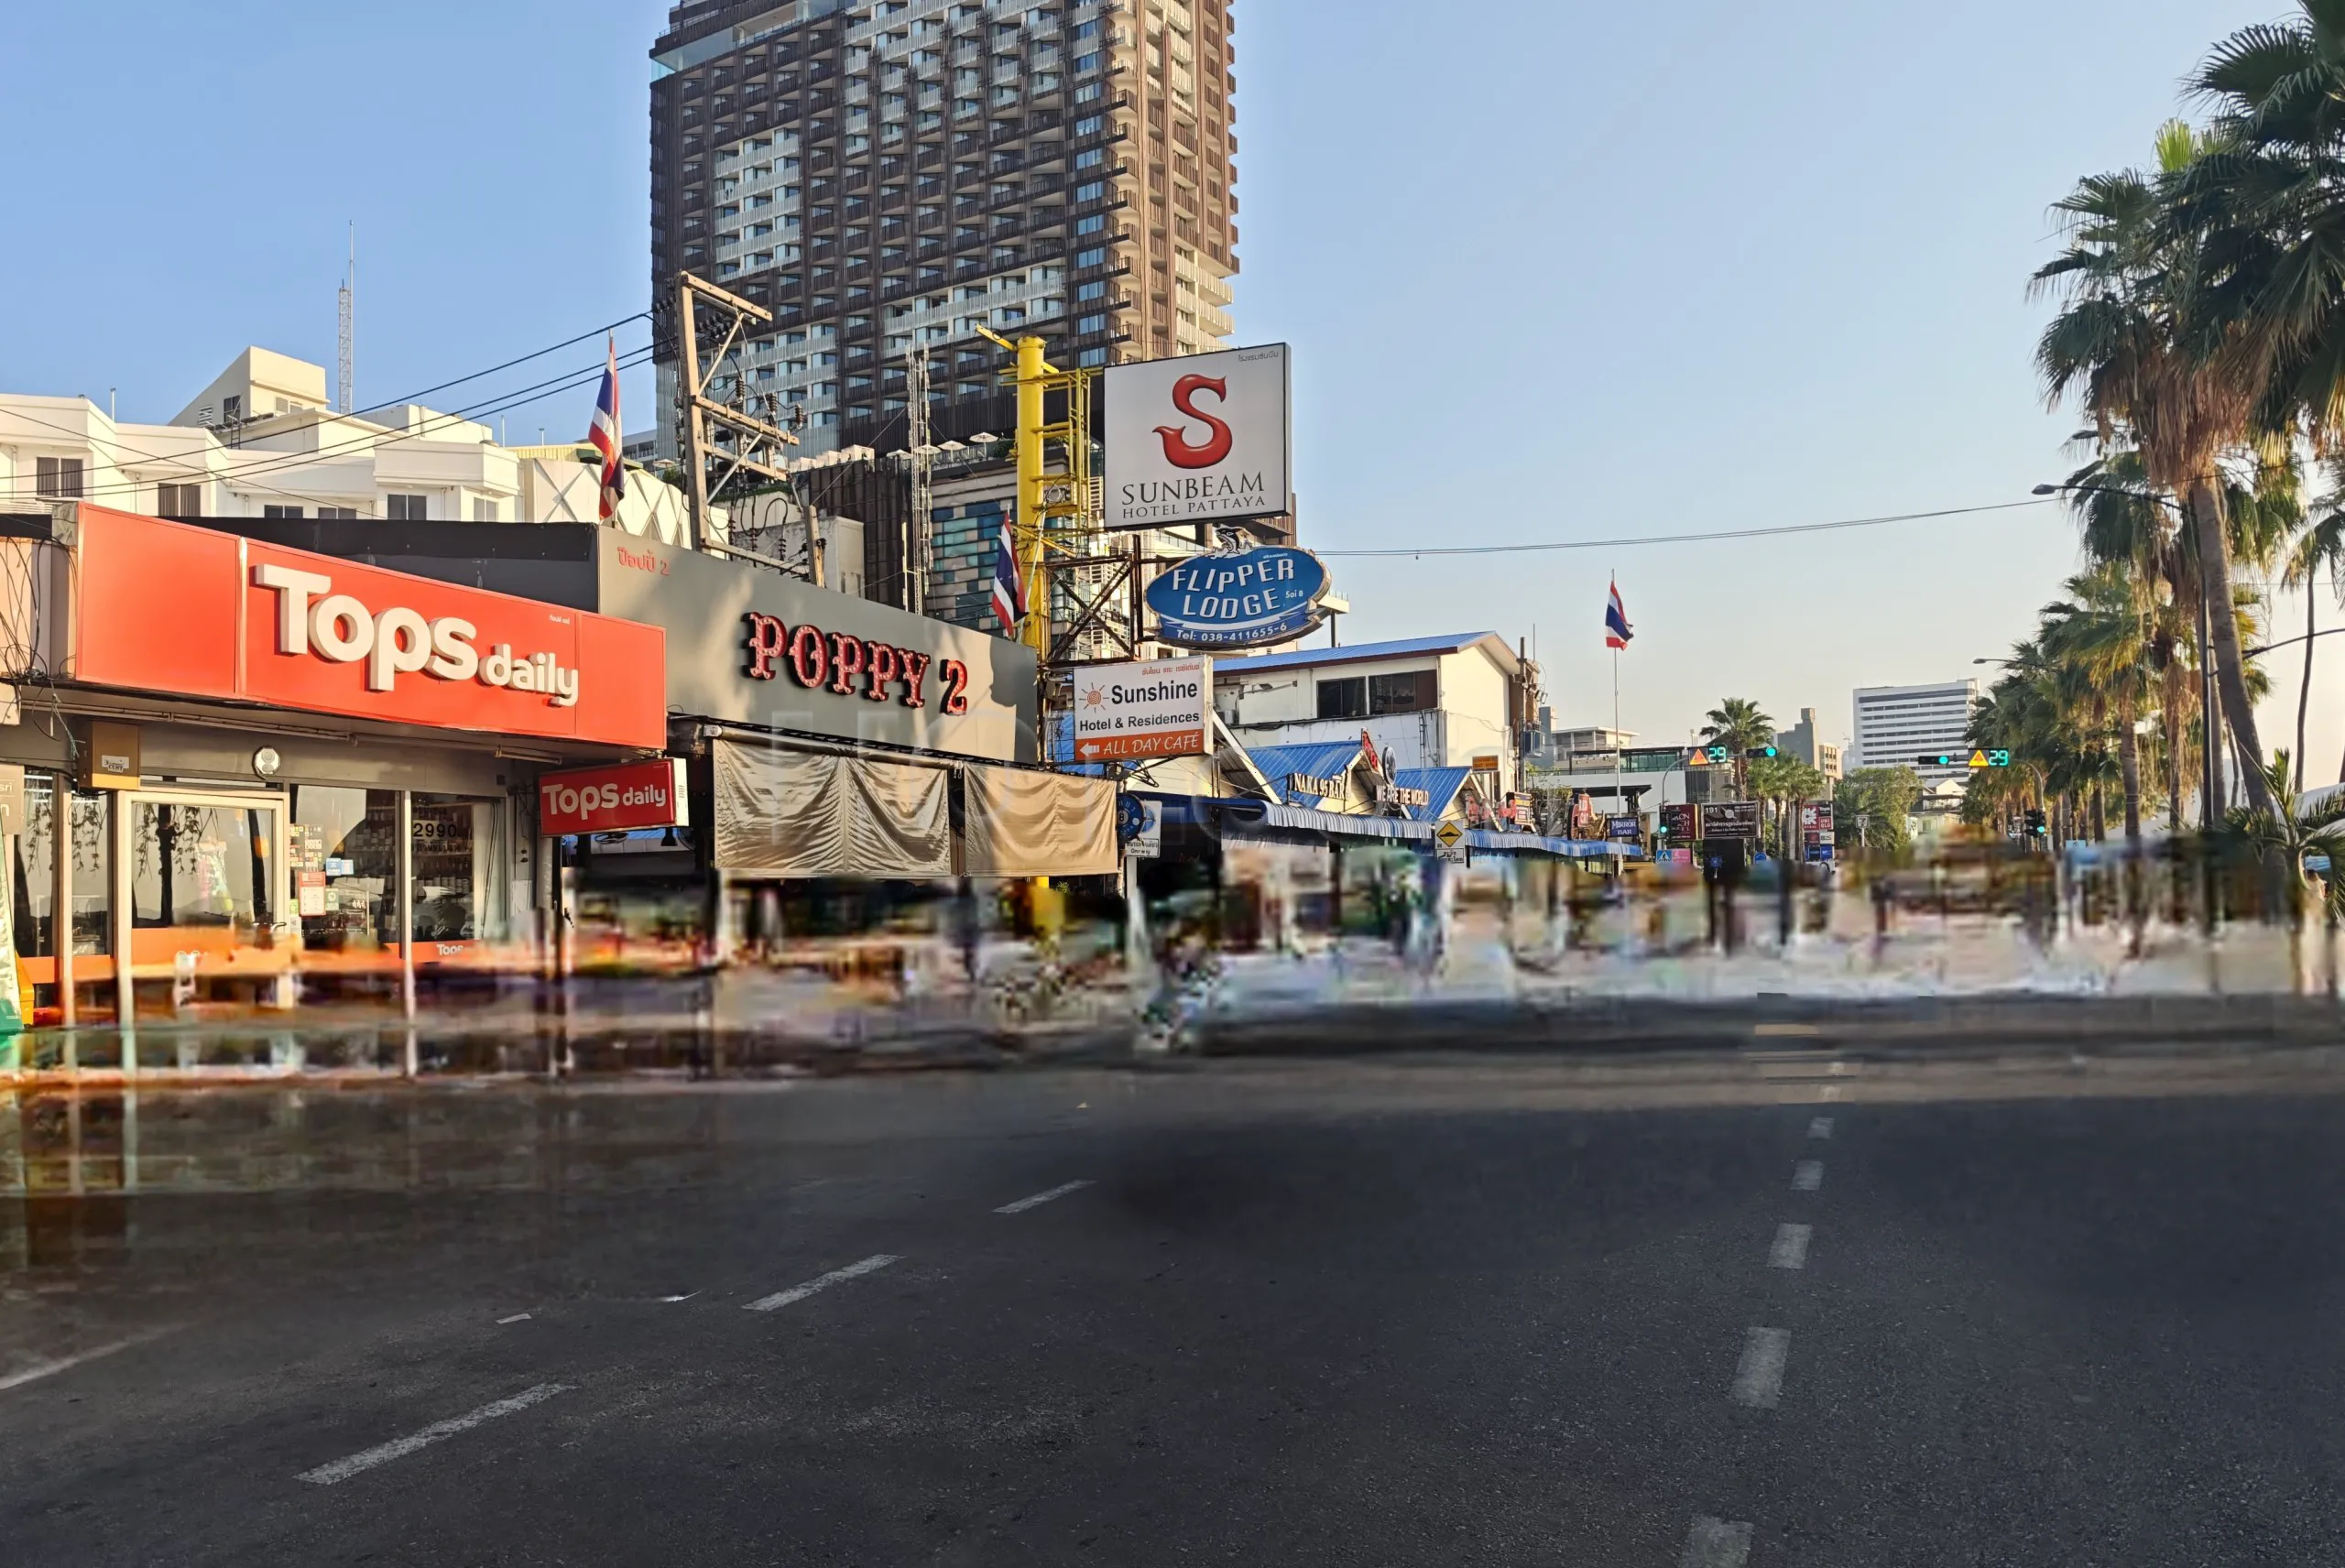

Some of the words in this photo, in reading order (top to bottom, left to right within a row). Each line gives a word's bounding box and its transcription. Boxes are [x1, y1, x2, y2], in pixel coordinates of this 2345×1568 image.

[1121, 471, 1264, 506] SUNBEAM
[1123, 505, 1180, 518] HOTEL
[1187, 495, 1266, 513] PATTAYA
[660, 560, 670, 576] 2
[1172, 559, 1294, 593] FLIPPER
[1183, 588, 1281, 619] LODGE
[1285, 589, 1297, 598] Soi
[255, 563, 478, 691] Tops
[479, 643, 579, 707] daily
[1176, 629, 1197, 641] Tel:
[1201, 622, 1287, 642] 038-411655-6
[747, 612, 931, 709] POPPY
[943, 659, 968, 716] 2
[1111, 680, 1198, 705] Sunshine
[1079, 717, 1111, 732] Hotel
[1115, 718, 1124, 729] &
[1128, 712, 1200, 728] Residences
[1103, 738, 1129, 756] ALL
[1132, 735, 1162, 752] DAY
[1164, 731, 1199, 750] CAFÉ
[1708, 746, 1727, 763] 29
[1989, 750, 2009, 766] 29
[1293, 772, 1319, 795] NAKA
[1319, 779, 1328, 796] 95
[1328, 779, 1345, 800] BAR
[1376, 784, 1386, 801] WE
[1400, 789, 1411, 804] THE
[1411, 789, 1429, 806] WORLD
[542, 783, 620, 821] Tops
[622, 784, 666, 808] daily
[413, 822, 457, 838] 2990
